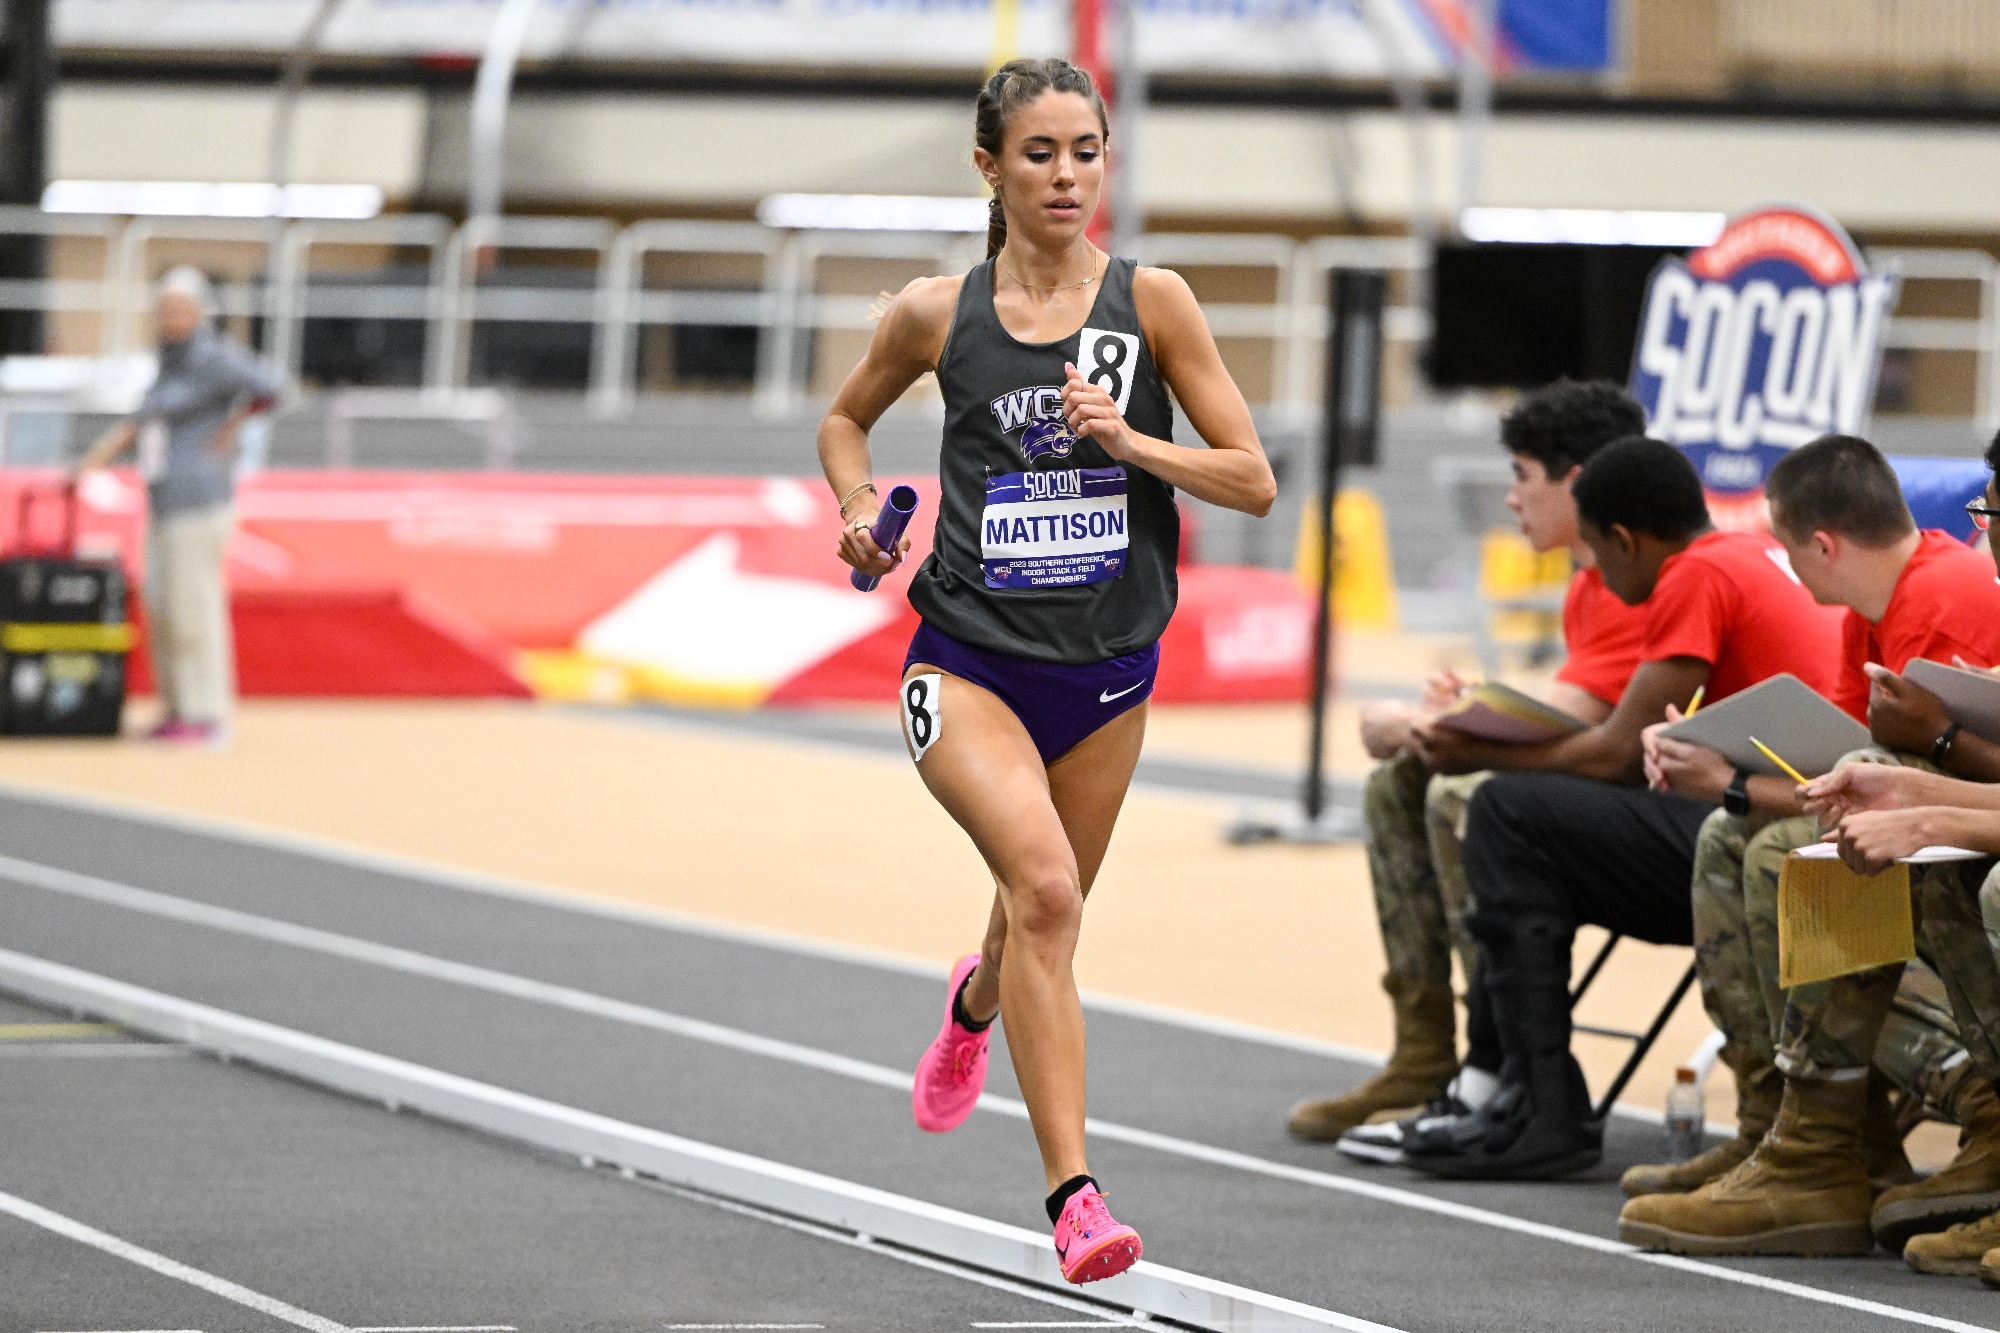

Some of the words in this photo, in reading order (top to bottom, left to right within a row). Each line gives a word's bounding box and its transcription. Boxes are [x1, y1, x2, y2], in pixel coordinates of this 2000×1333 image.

[1088, 335, 1128, 404] 8
[1641, 267, 1890, 448] SOCON
[990, 385, 1065, 434] WC
[1023, 468, 1082, 501] SOCON
[986, 509, 1124, 545] MATTISON
[993, 566, 1012, 575] WCU
[1021, 568, 1046, 577] INDOOR
[1047, 566, 1070, 576] TRACK
[1078, 564, 1096, 573] FIELD
[1028, 558, 1063, 568] SOUTHERN
[1064, 554, 1106, 566] CONFERENCE
[1104, 558, 1120, 567] WCU
[1031, 574, 1087, 585] CHAMPIONSHIPS
[907, 679, 932, 749] 8
